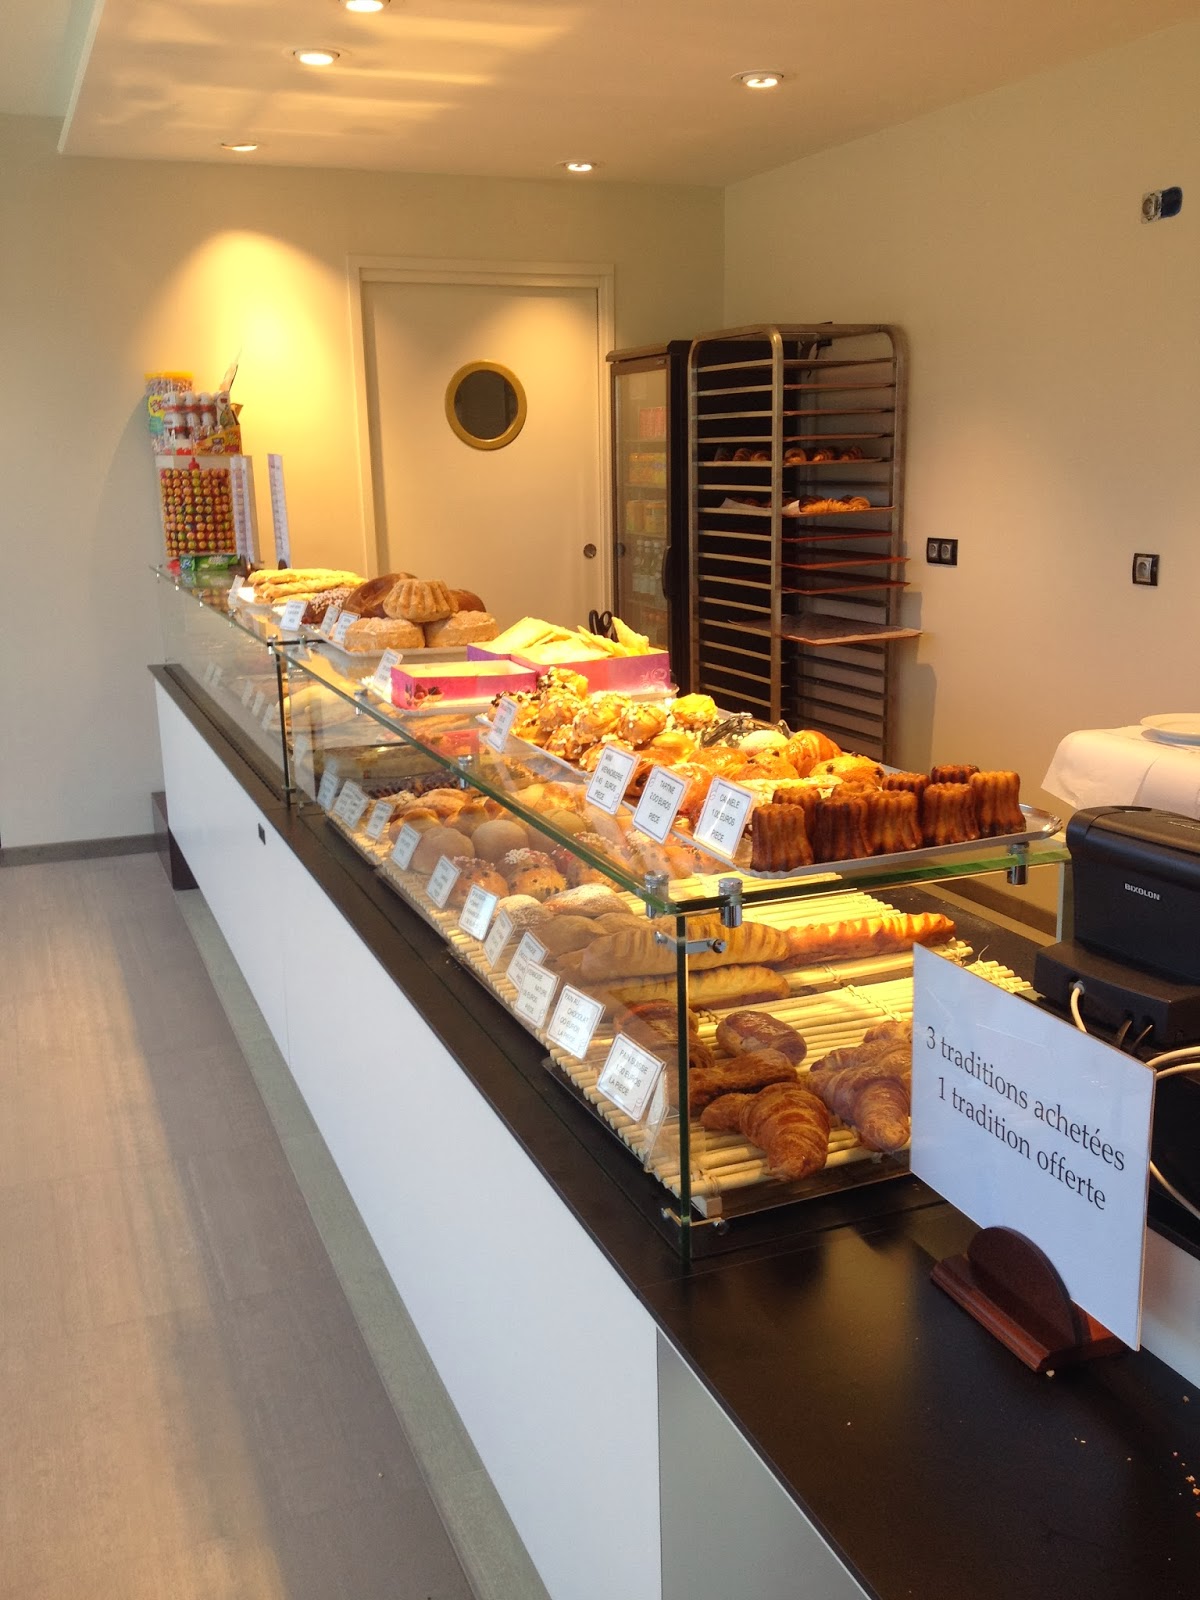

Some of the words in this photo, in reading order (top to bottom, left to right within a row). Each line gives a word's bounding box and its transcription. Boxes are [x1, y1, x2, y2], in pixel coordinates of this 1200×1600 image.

[660, 779, 676, 795] TARTINE
[657, 797, 672, 811] EUROS
[719, 794, 740, 809] CANELE
[648, 812, 660, 825] PIECE
[720, 812, 736, 827] EUROS
[710, 829, 724, 843] PIECE
[1124, 882, 1161, 901] BIXOLON
[619, 1049, 632, 1063] PAIN
[629, 1057, 649, 1075] SUISSE
[608, 1076, 615, 1086] LA
[614, 1080, 630, 1097] PIECE
[624, 1068, 642, 1088] EUROS
[926, 1025, 936, 1050] 3
[941, 1037, 1029, 1110] traditions
[1034, 1099, 1126, 1172] achetées
[937, 1076, 946, 1101] 1
[952, 1086, 1031, 1160] tradition
[1036, 1149, 1107, 1211] offerte
